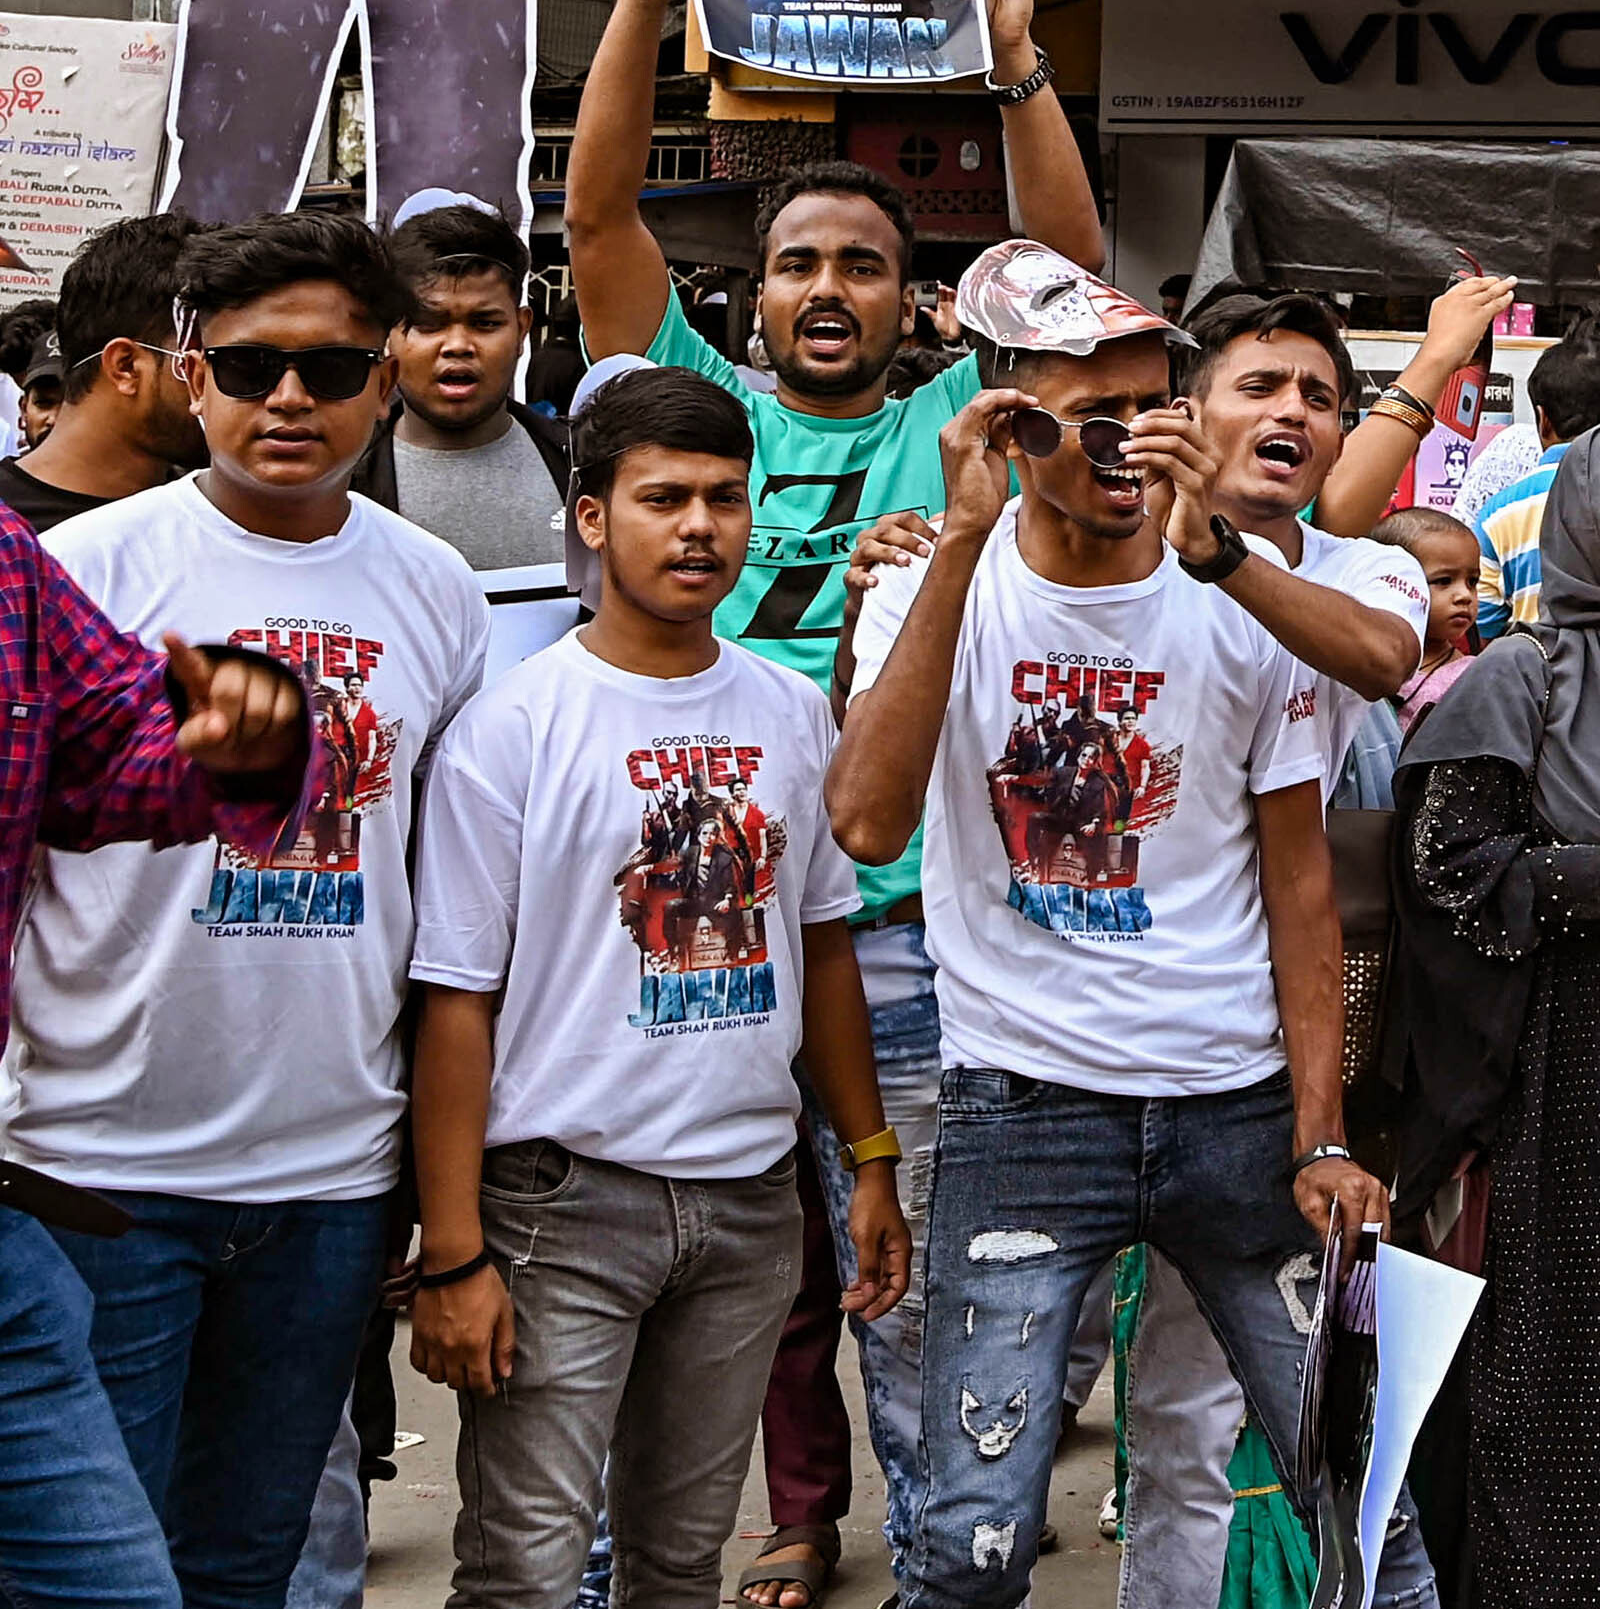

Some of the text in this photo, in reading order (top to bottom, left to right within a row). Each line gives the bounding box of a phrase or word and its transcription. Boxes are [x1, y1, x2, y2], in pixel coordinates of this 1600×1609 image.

[739, 12, 956, 78] JAWAN
[1112, 95, 1154, 108] GSTIN
[42, 129, 72, 139] tribute
[19, 137, 82, 158] nazrul
[87, 139, 137, 161] islam
[30, 181, 69, 193] RUDRA
[12, 194, 84, 208] DEEPABALI
[86, 199, 123, 211] DUTTA
[19, 222, 84, 235] DEBASISH
[264, 617, 353, 635] GOOD TO GO
[1046, 651, 1134, 669] GOOD TO GO
[1010, 659, 1166, 715] CHIEF
[651, 734, 731, 748] GOOD TO GO
[625, 746, 765, 792] CHIEF
[191, 868, 364, 925] JAWAN
[207, 925, 356, 939] TEAM SHAH RUKH KHAN
[1107, 932, 1145, 943] KHAN
[626, 961, 778, 1029] JAWAN
[643, 1014, 771, 1040] TEAM SHAH RUKH KHAN
